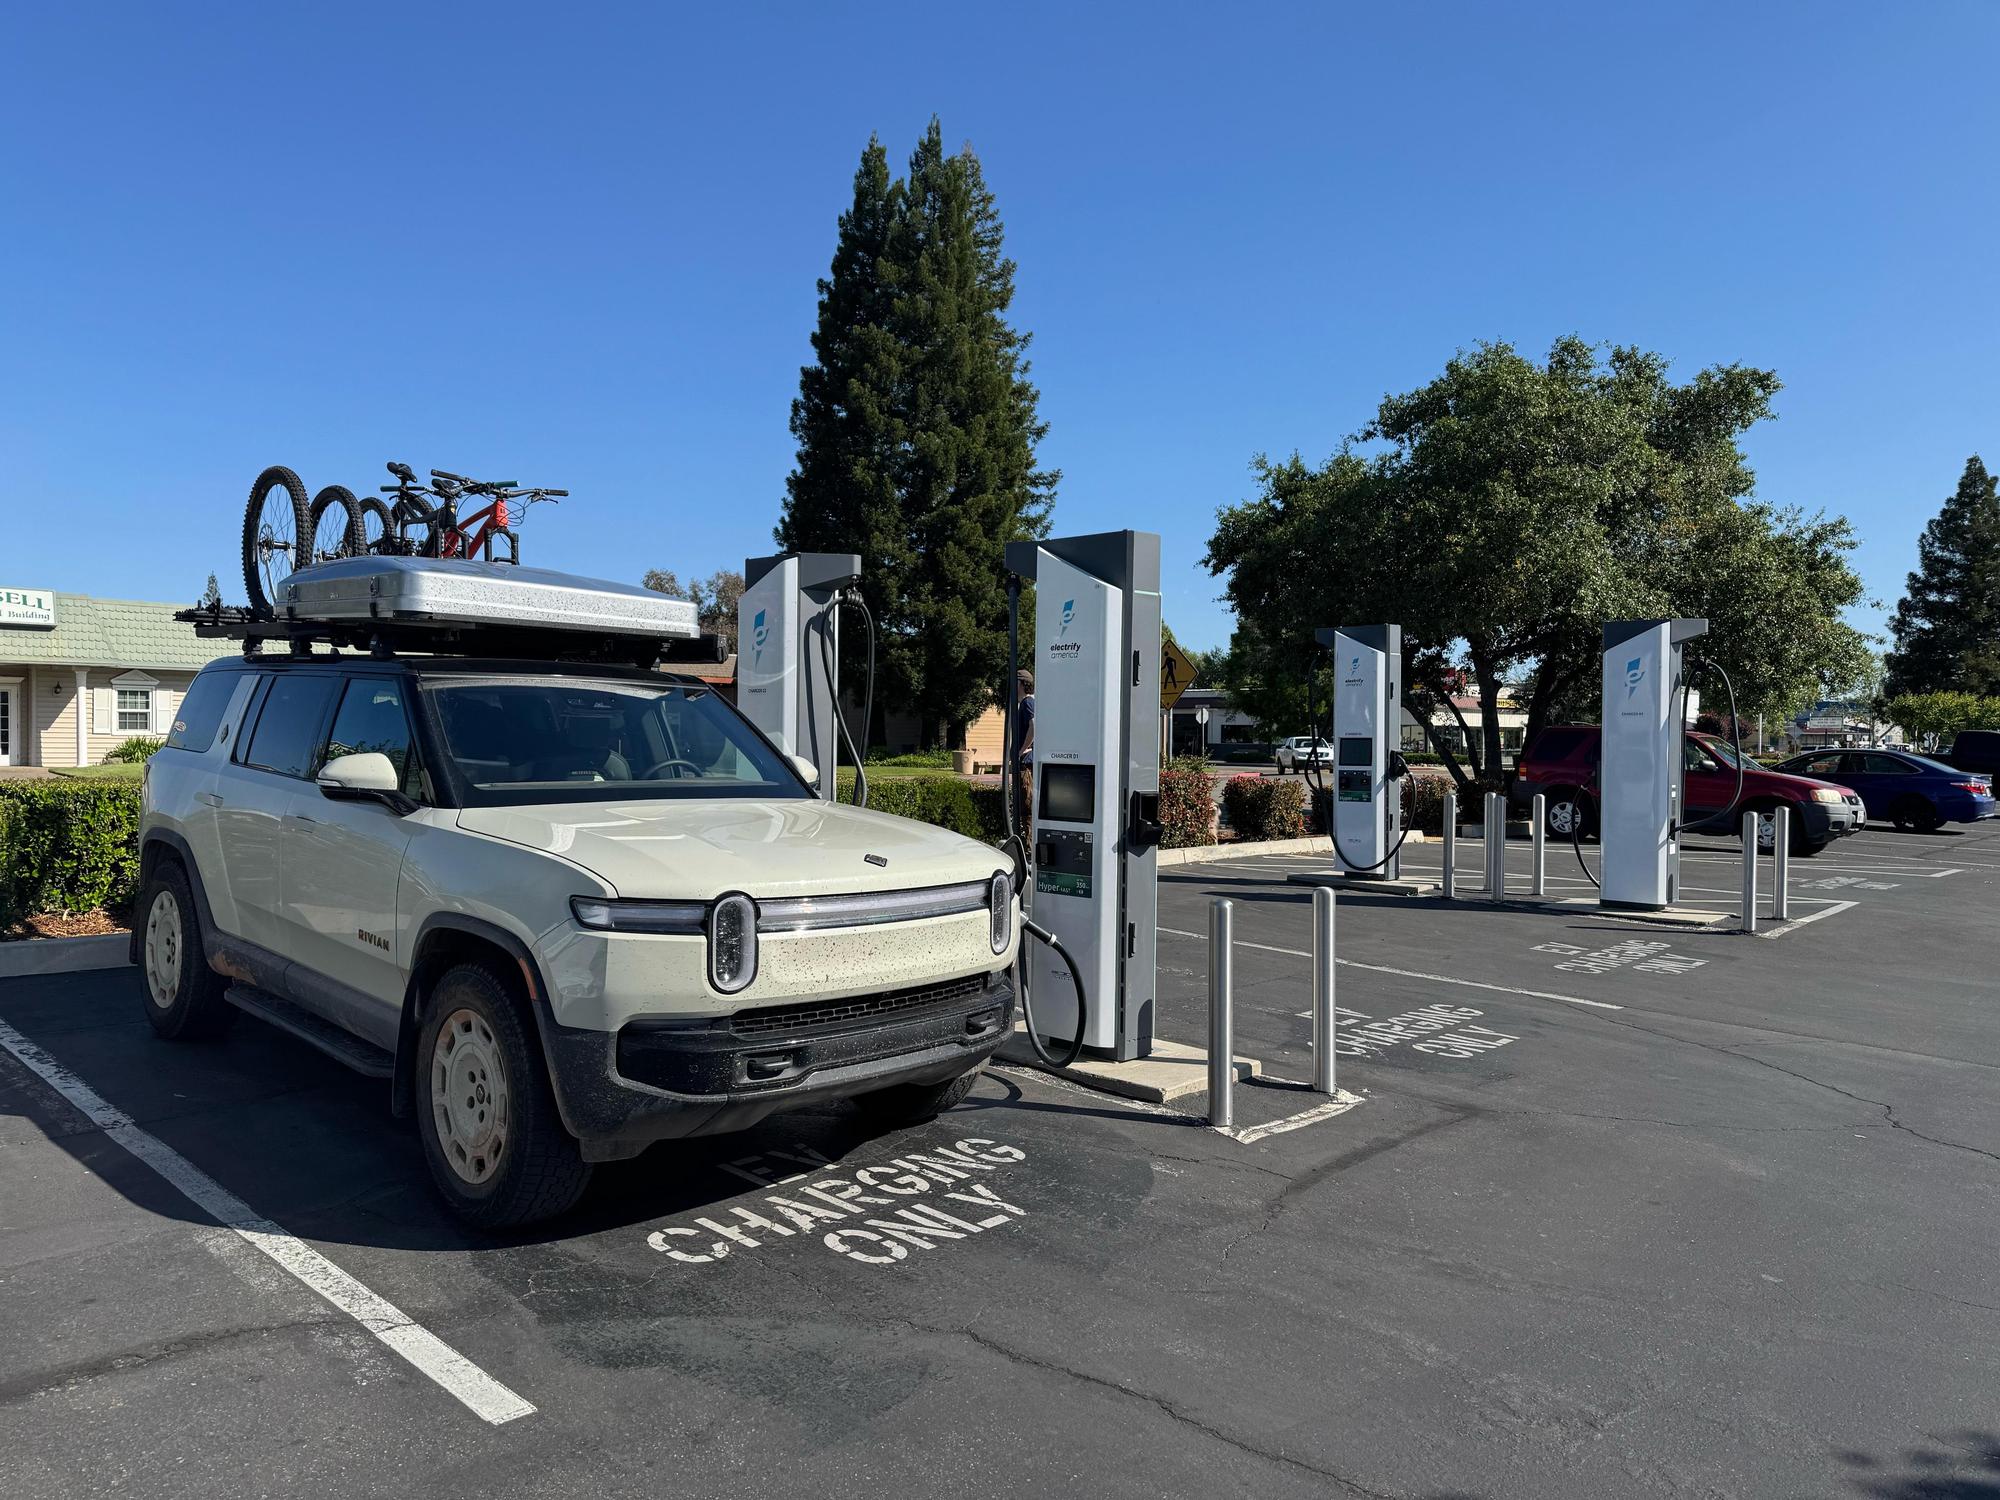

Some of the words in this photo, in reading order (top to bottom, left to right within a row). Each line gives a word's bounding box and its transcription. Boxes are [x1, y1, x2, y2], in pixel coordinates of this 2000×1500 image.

[8, 611, 50, 621] Building
[1050, 642, 1081, 652] electrify
[358, 928, 390, 952] RIVIAN
[1633, 953, 1710, 975] ONLY
[1412, 1025, 1521, 1058] ONLY
[716, 1143, 840, 1188] EV
[646, 1138, 1026, 1263] CHARGING
[823, 1183, 1027, 1264] ONLY
